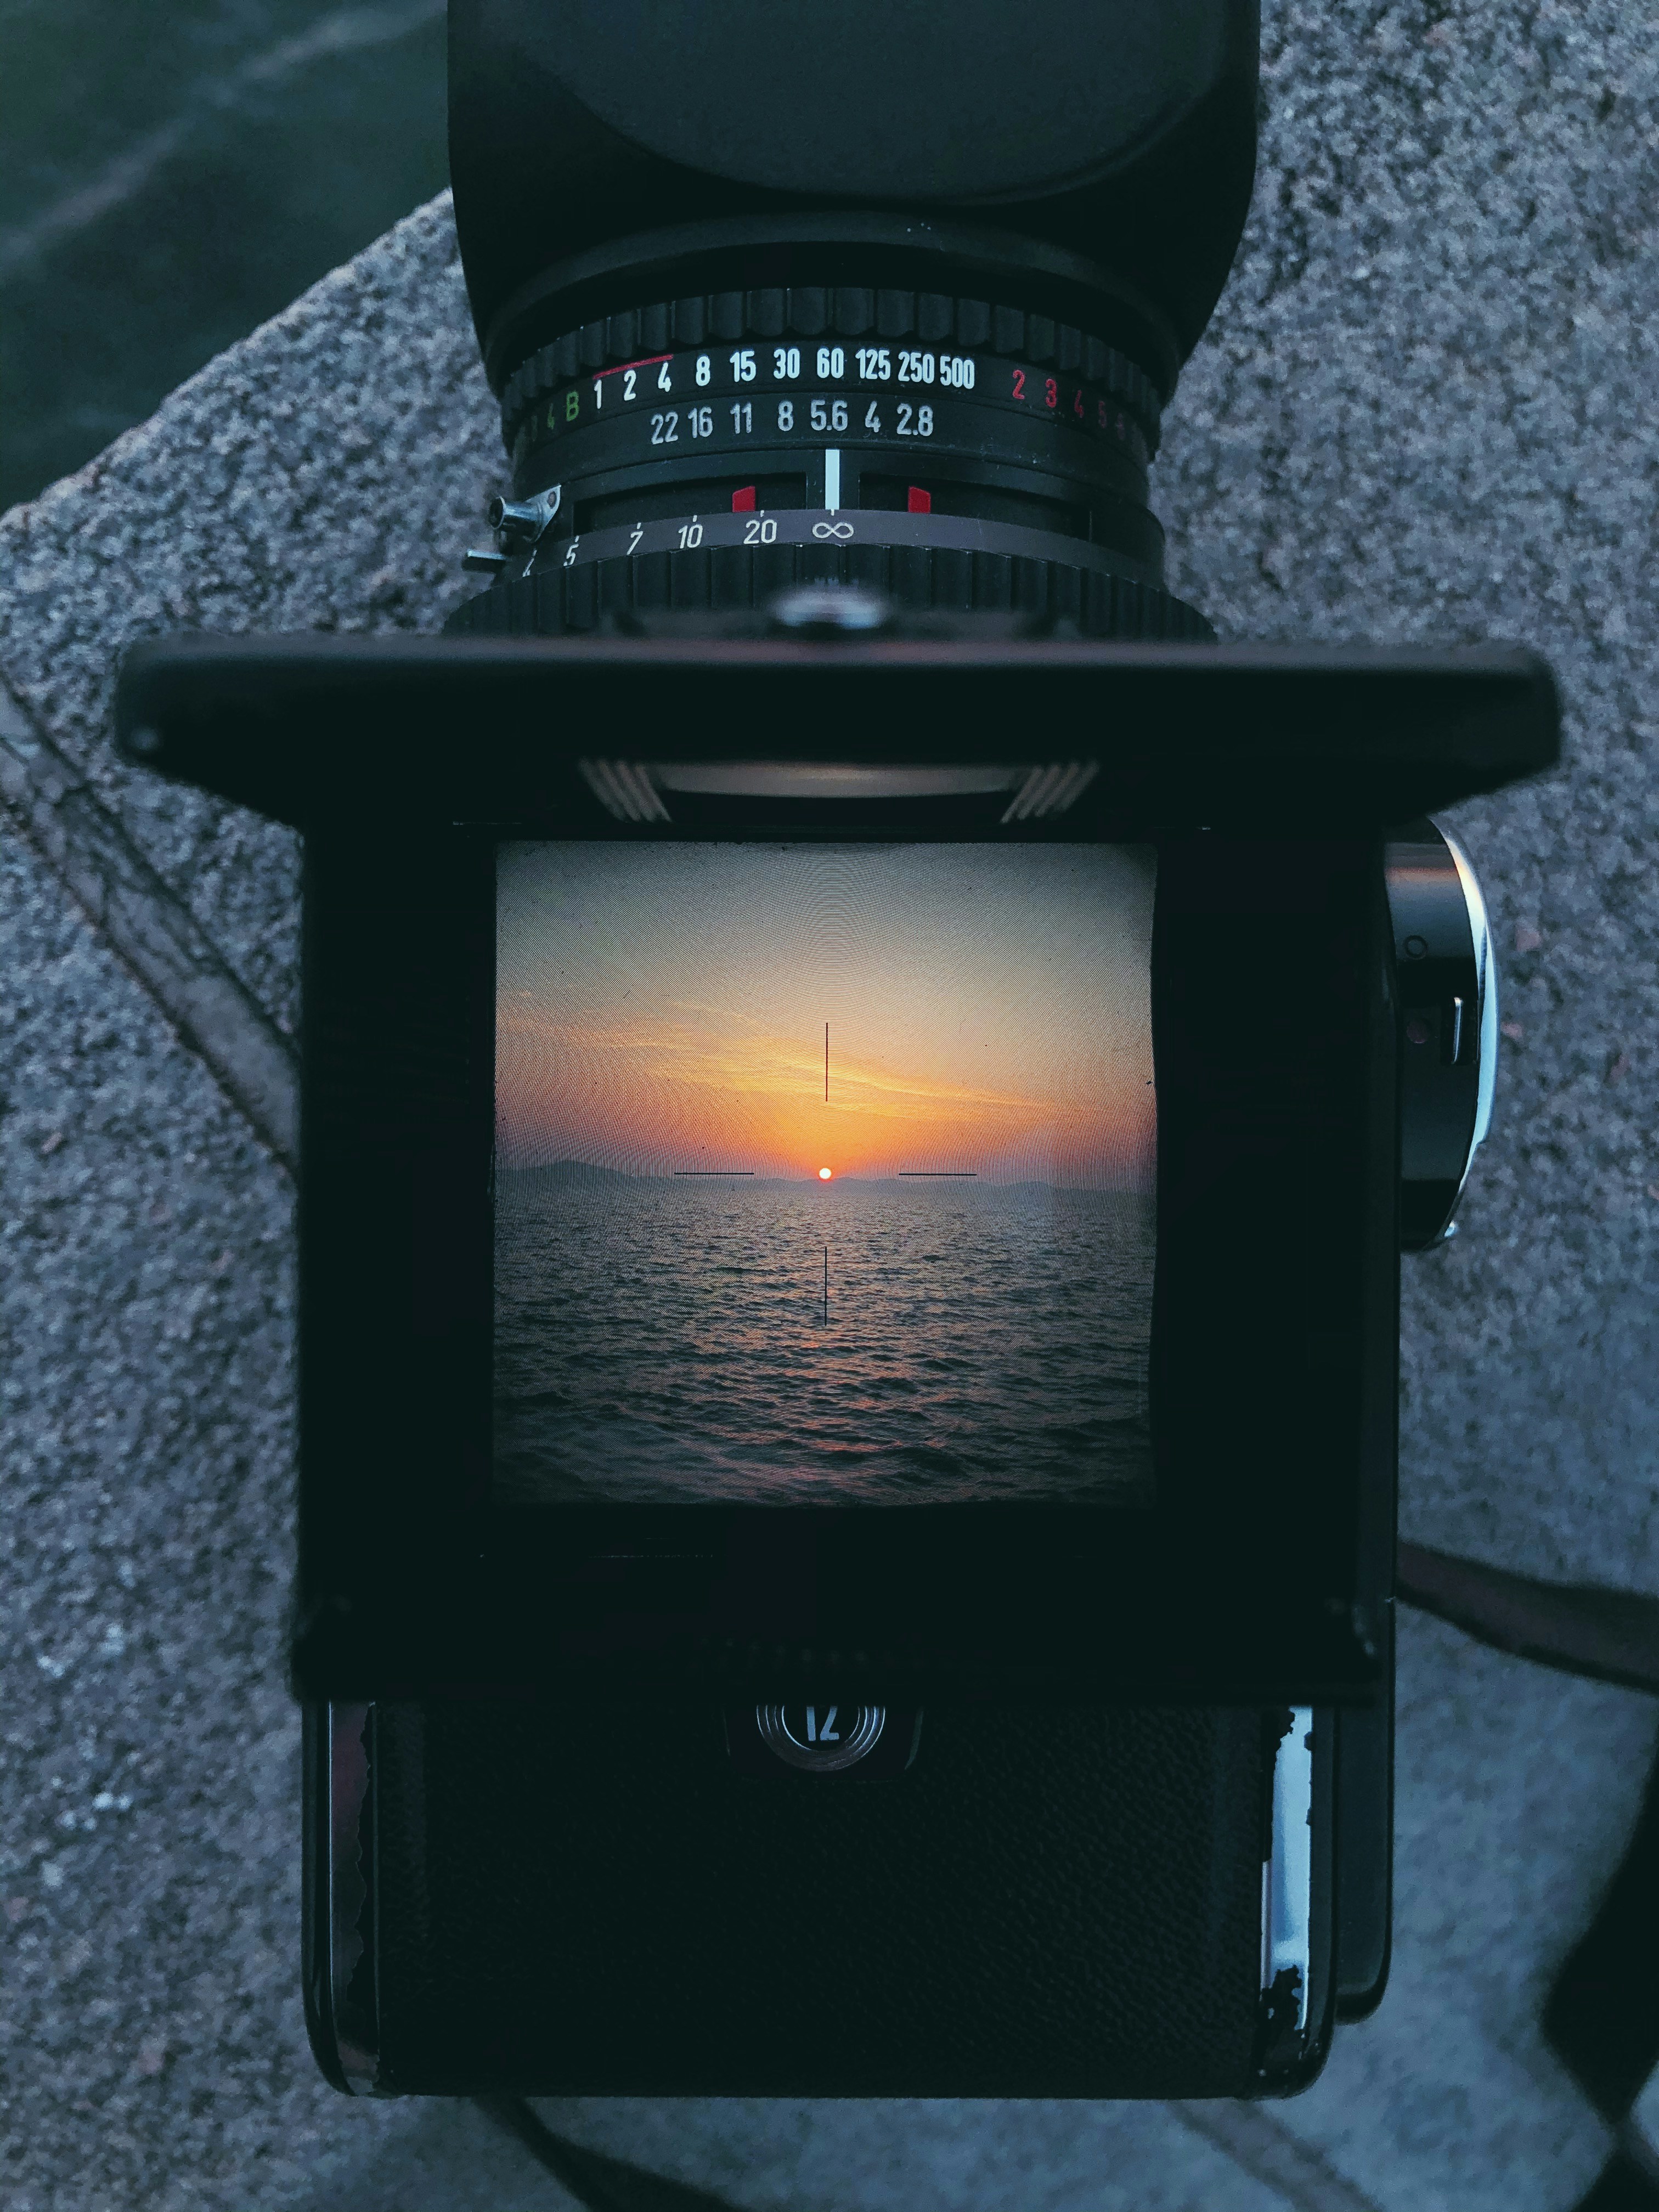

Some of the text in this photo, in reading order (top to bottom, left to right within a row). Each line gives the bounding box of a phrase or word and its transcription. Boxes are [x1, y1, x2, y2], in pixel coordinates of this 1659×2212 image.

[566, 391, 579, 422] B
[594, 380, 602, 409] 1
[623, 370, 637, 401] 2
[657, 362, 672, 393] 4
[695, 353, 712, 387] 8
[729, 348, 757, 383] 15
[774, 346, 801, 380] 30
[816, 346, 848, 380] 60
[853, 347, 891, 380] 125
[898, 349, 935, 384] 250
[939, 354, 975, 390] 500
[1012, 369, 1026, 400] 2
[1045, 379, 1058, 408] 3
[1074, 390, 1085, 419] 4
[650, 399, 934, 445] 22 16 11 8 5.6 4 2.8
[563, 543, 579, 567] 5
[626, 531, 644, 555] 7
[678, 524, 703, 549] 10
[743, 519, 777, 545] 20
